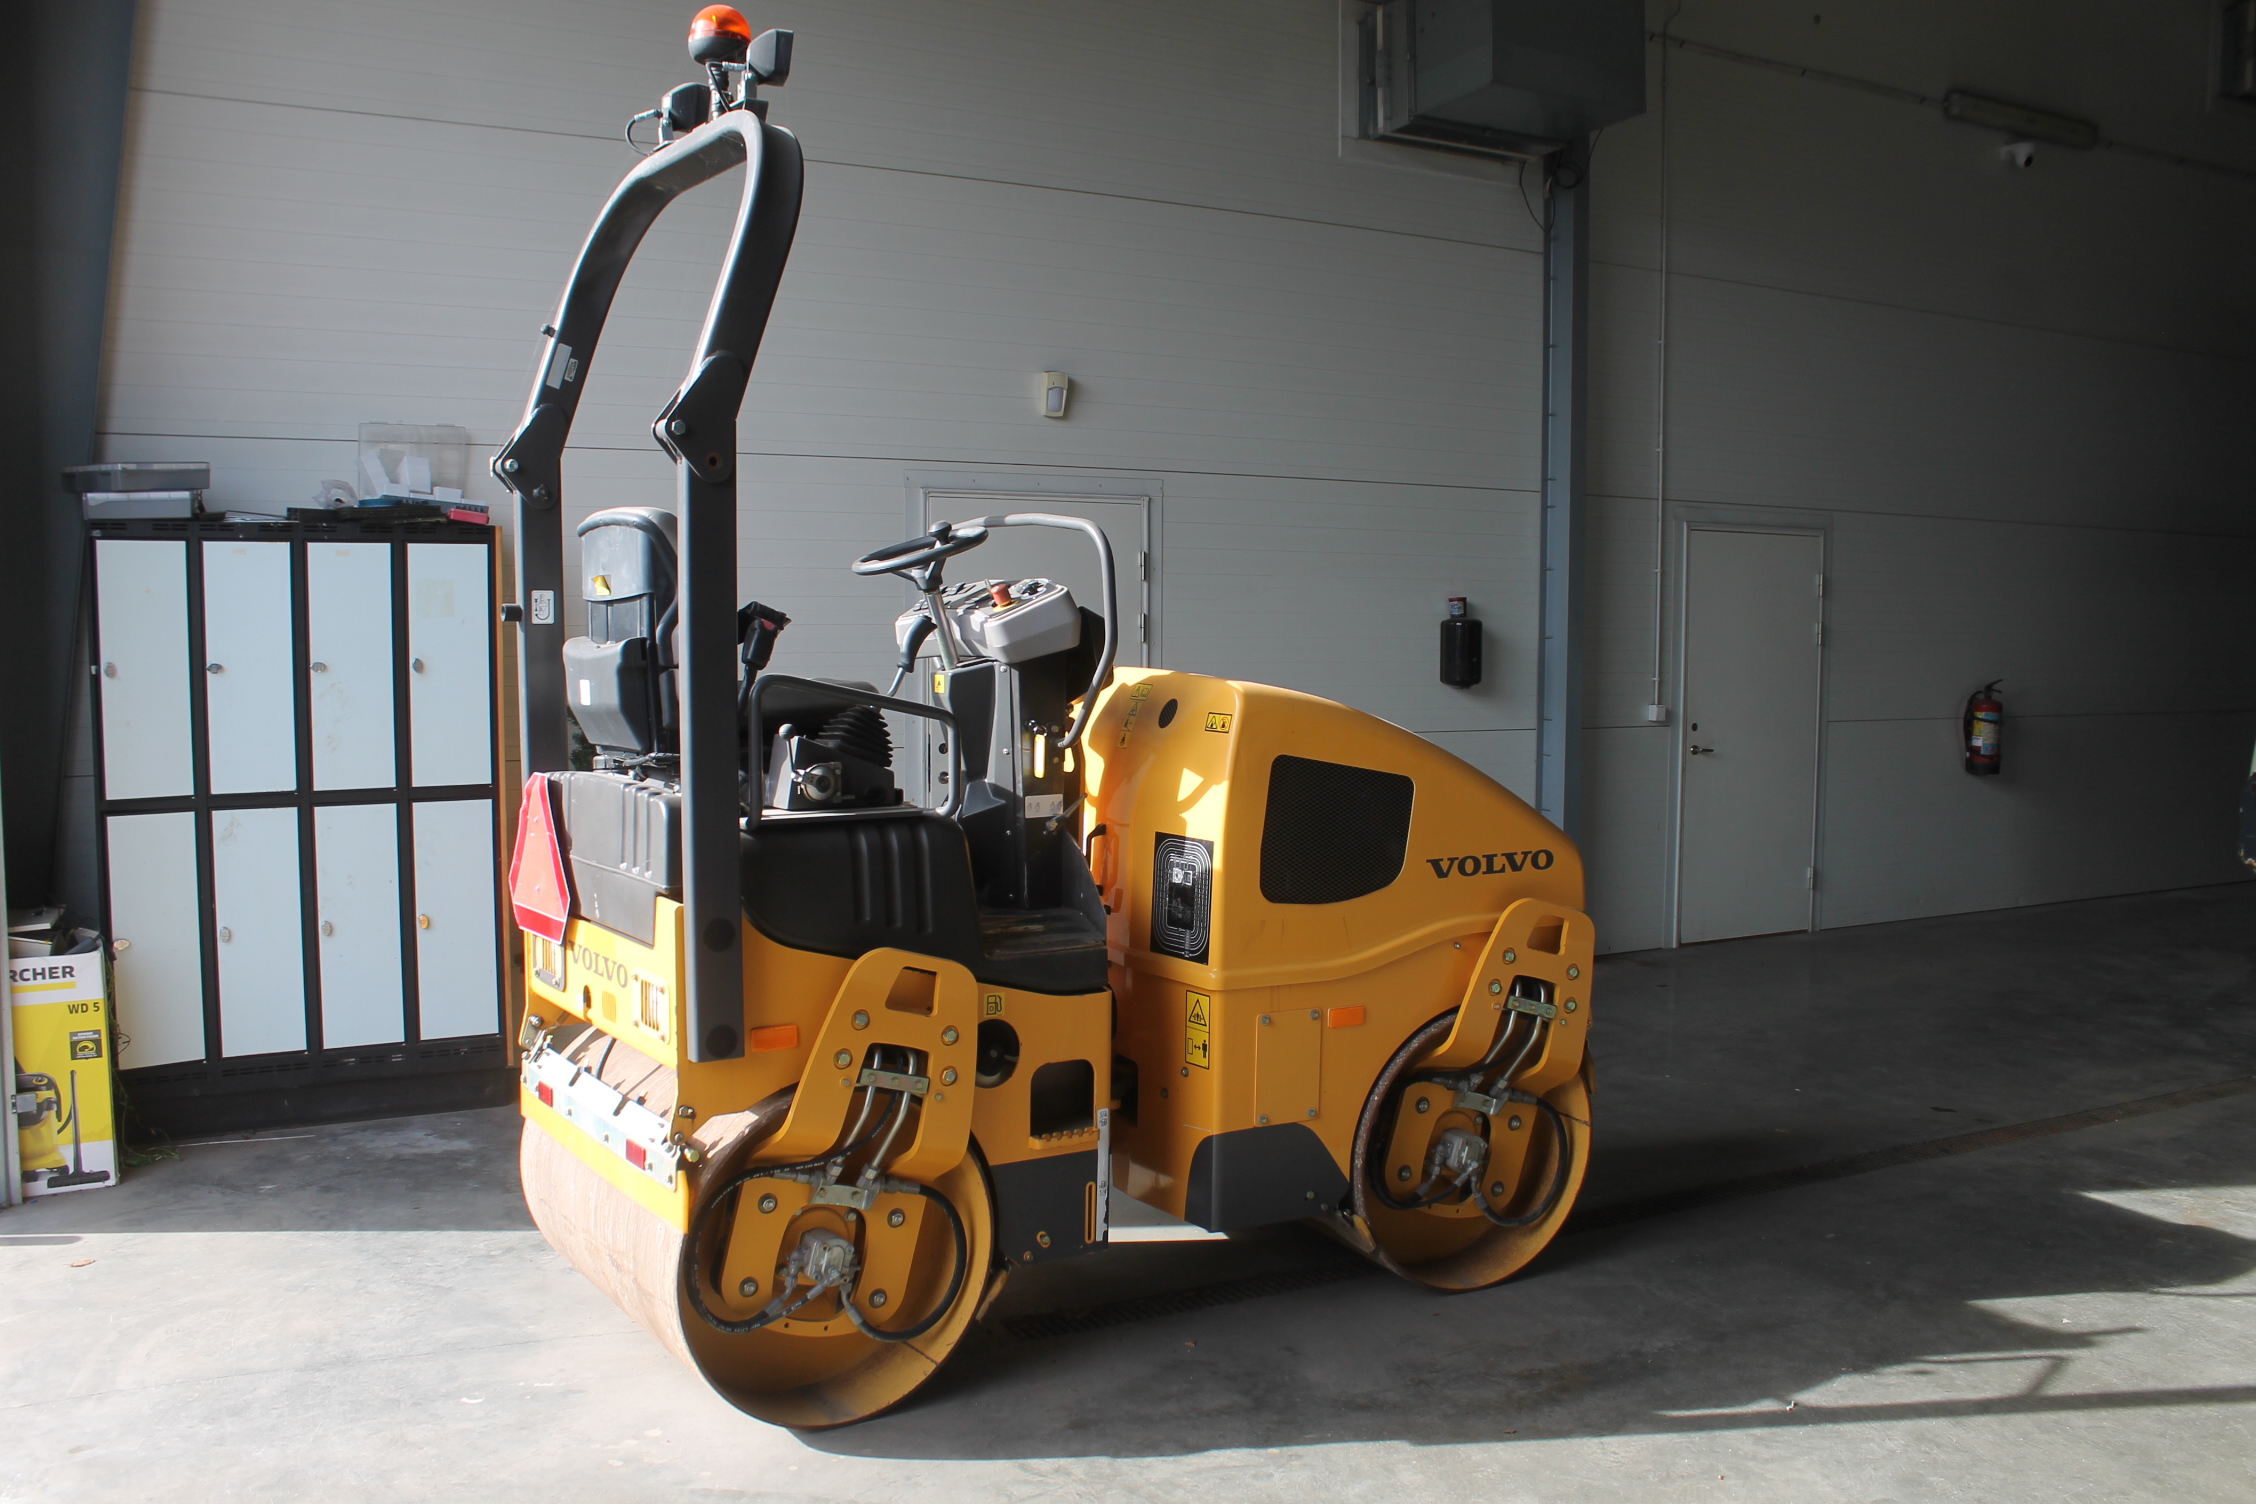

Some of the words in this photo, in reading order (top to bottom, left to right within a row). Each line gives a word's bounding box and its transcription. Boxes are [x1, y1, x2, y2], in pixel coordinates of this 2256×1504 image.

[1426, 849, 1555, 879] VOLVO
[9, 965, 76, 982] RCHER
[568, 939, 629, 989] VOLVO
[68, 1003, 89, 1015] WD
[93, 1001, 100, 1013] 5
